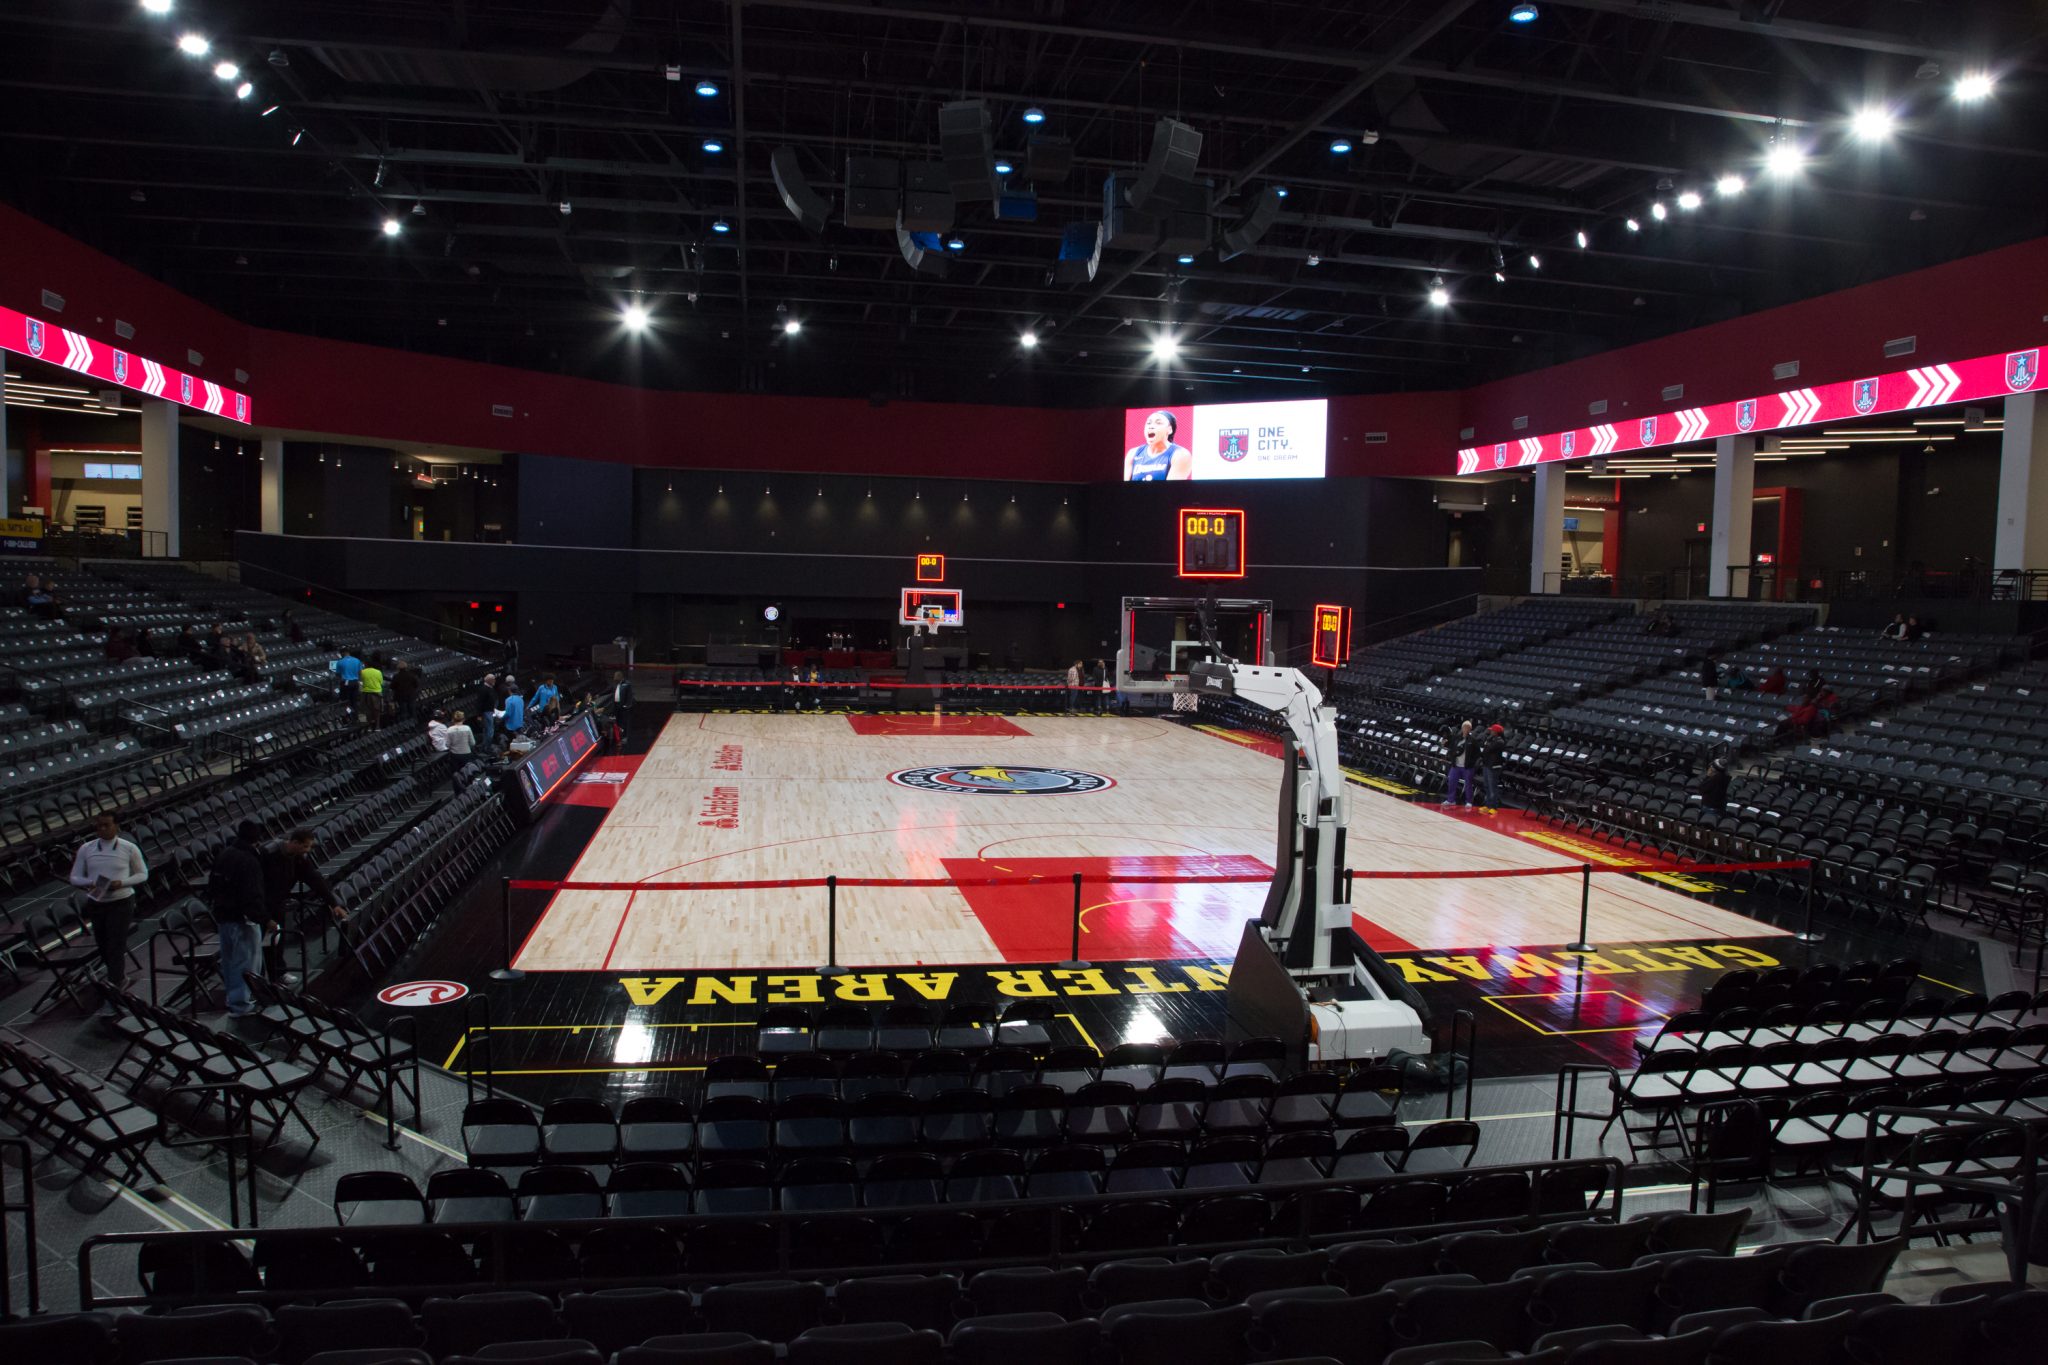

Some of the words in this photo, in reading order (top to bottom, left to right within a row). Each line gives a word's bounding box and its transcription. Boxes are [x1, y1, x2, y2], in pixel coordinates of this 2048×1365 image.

[1258, 426, 1285, 437] ONE
[1273, 453, 1298, 461] DREAM
[987, 963, 1233, 998] NTER
[1385, 945, 1781, 983] GATEWAY
[619, 973, 959, 1006] ARENA
